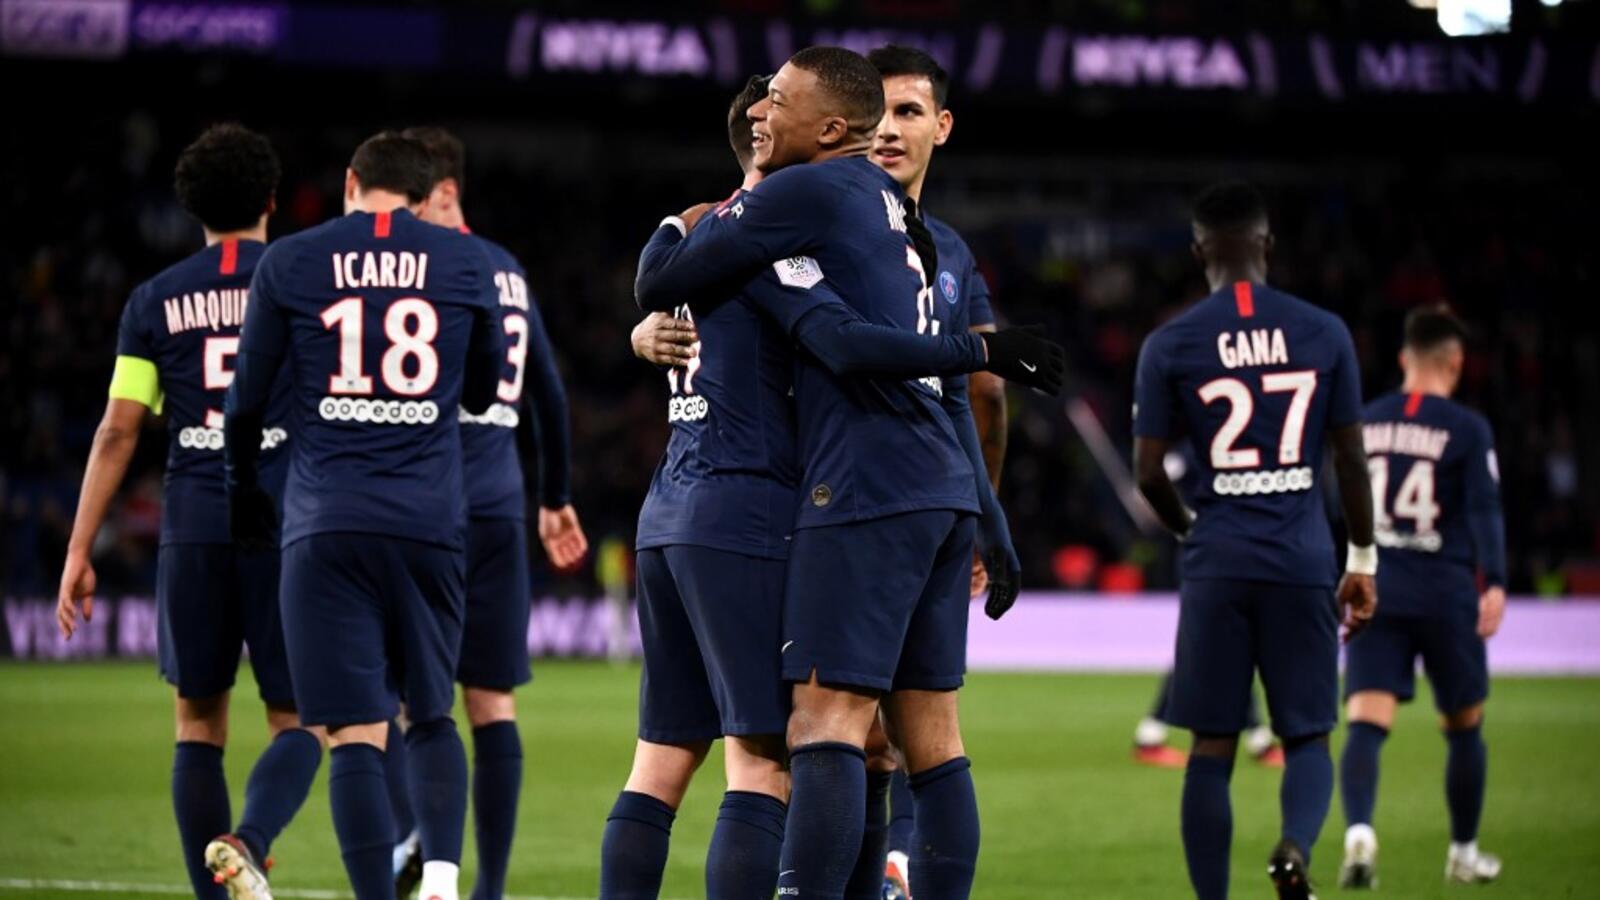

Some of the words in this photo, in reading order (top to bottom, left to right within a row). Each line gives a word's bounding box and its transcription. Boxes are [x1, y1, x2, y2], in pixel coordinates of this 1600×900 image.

[541, 23, 708, 75] NIVEA
[1073, 37, 1247, 88] NIVEA
[1358, 44, 1499, 91] MEN
[332, 251, 428, 290] ICARDI
[319, 297, 440, 396] 18
[497, 314, 528, 402] 3
[1217, 327, 1289, 369] GANA
[318, 396, 440, 425] ooredoo
[1197, 370, 1318, 469] 27
[1366, 455, 1442, 535] 14
